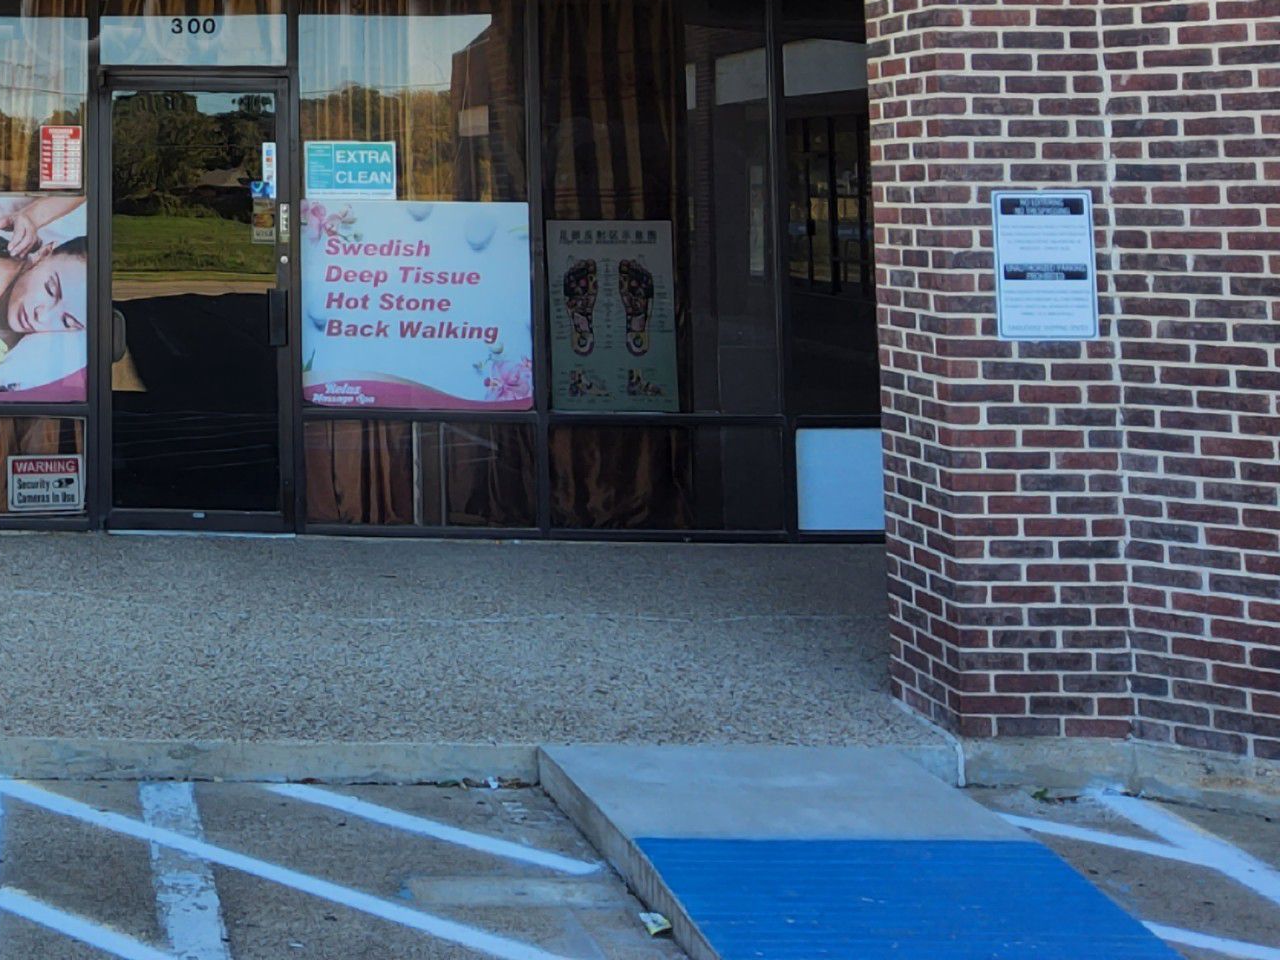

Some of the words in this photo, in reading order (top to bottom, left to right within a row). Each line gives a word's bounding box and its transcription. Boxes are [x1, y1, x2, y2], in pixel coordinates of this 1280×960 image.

[170, 17, 216, 35] 300
[335, 149, 392, 164] EXTRA
[335, 170, 392, 184] CLEAN
[325, 238, 431, 257] Swedish
[324, 265, 389, 287] Deep
[398, 266, 481, 285] Tissue
[325, 292, 370, 310] Hot
[378, 293, 452, 312] Stone
[326, 319, 390, 338] Back
[399, 320, 499, 344] Walking
[15, 460, 76, 473] WARNING
[16, 477, 50, 491] Security
[16, 492, 50, 504] Cameras
